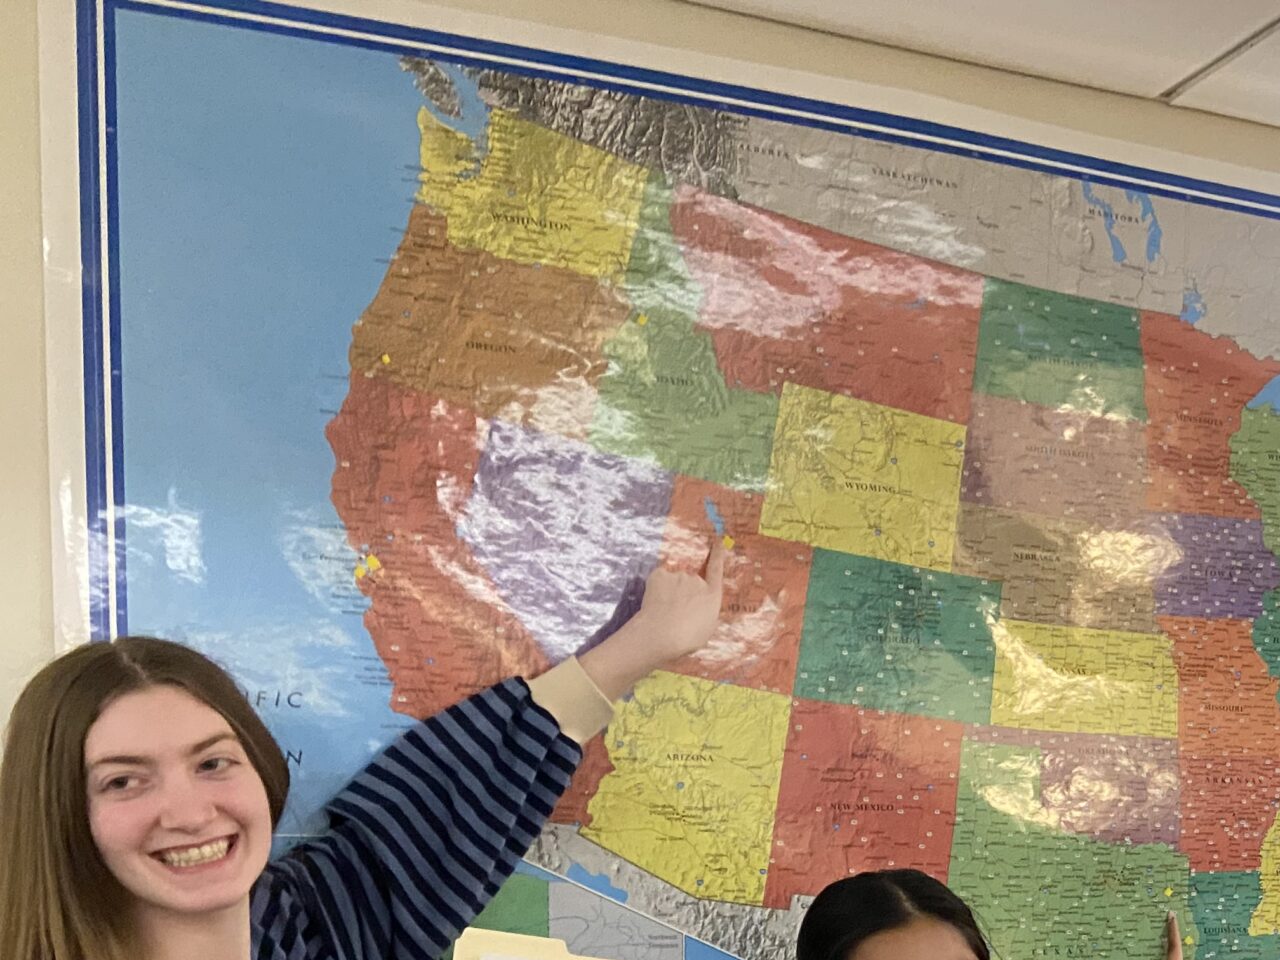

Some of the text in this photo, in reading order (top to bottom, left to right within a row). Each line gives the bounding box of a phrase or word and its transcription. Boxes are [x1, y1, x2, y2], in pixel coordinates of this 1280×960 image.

[491, 211, 572, 232] WASHINGTON
[465, 341, 517, 354] OREGON
[1175, 413, 1224, 427] MINNESOTA
[844, 481, 896, 494] WYOMING
[1013, 551, 1061, 563] NEBRASKA
[1204, 569, 1234, 578] IOWA
[1204, 704, 1244, 713] MISSOURI
[665, 753, 714, 763] ARIZONA
[1204, 776, 1264, 785] ARKANSAS
[830, 802, 895, 812] NEW MEXICO
[1203, 926, 1248, 935] LOUISIANA
[1032, 947, 1085, 956] TEXAS
